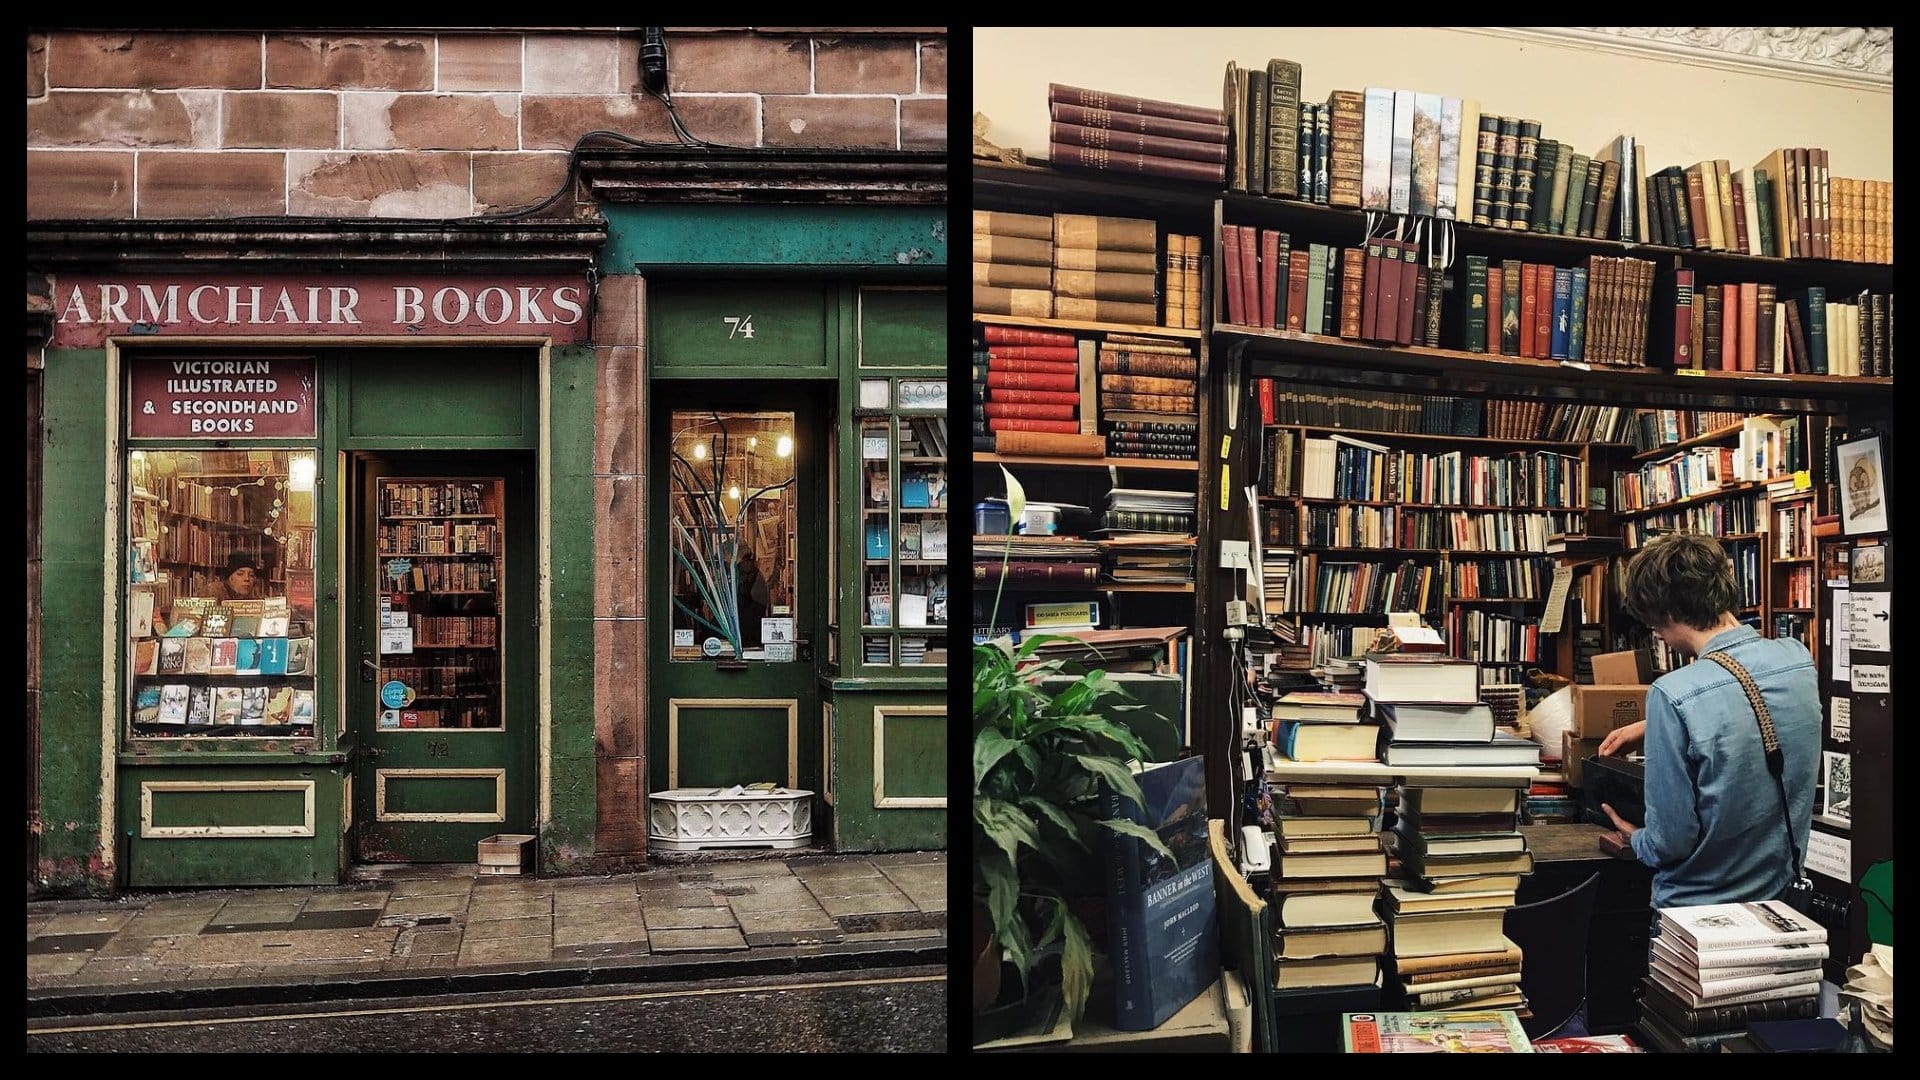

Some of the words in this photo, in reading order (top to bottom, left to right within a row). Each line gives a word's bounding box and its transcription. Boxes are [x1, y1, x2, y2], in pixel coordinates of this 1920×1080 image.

[57, 284, 363, 325] ARMCHAIR
[393, 286, 583, 325] BOOKS
[723, 314, 755, 340] 74
[172, 361, 270, 376] VICTORIAN
[166, 378, 278, 394] ILLUSTRATED
[143, 401, 156, 415] &
[172, 400, 299, 415] SECONDHAND
[191, 418, 255, 434] BOOKS
[173, 599, 217, 608] PRATCHETT
[404, 712, 418, 720] PRS
[1147, 881, 1177, 908] BANNER
[1191, 864, 1209, 882] WEST
[1163, 917, 1178, 930] JOHN
[1178, 902, 1200, 920] MACLEOD
